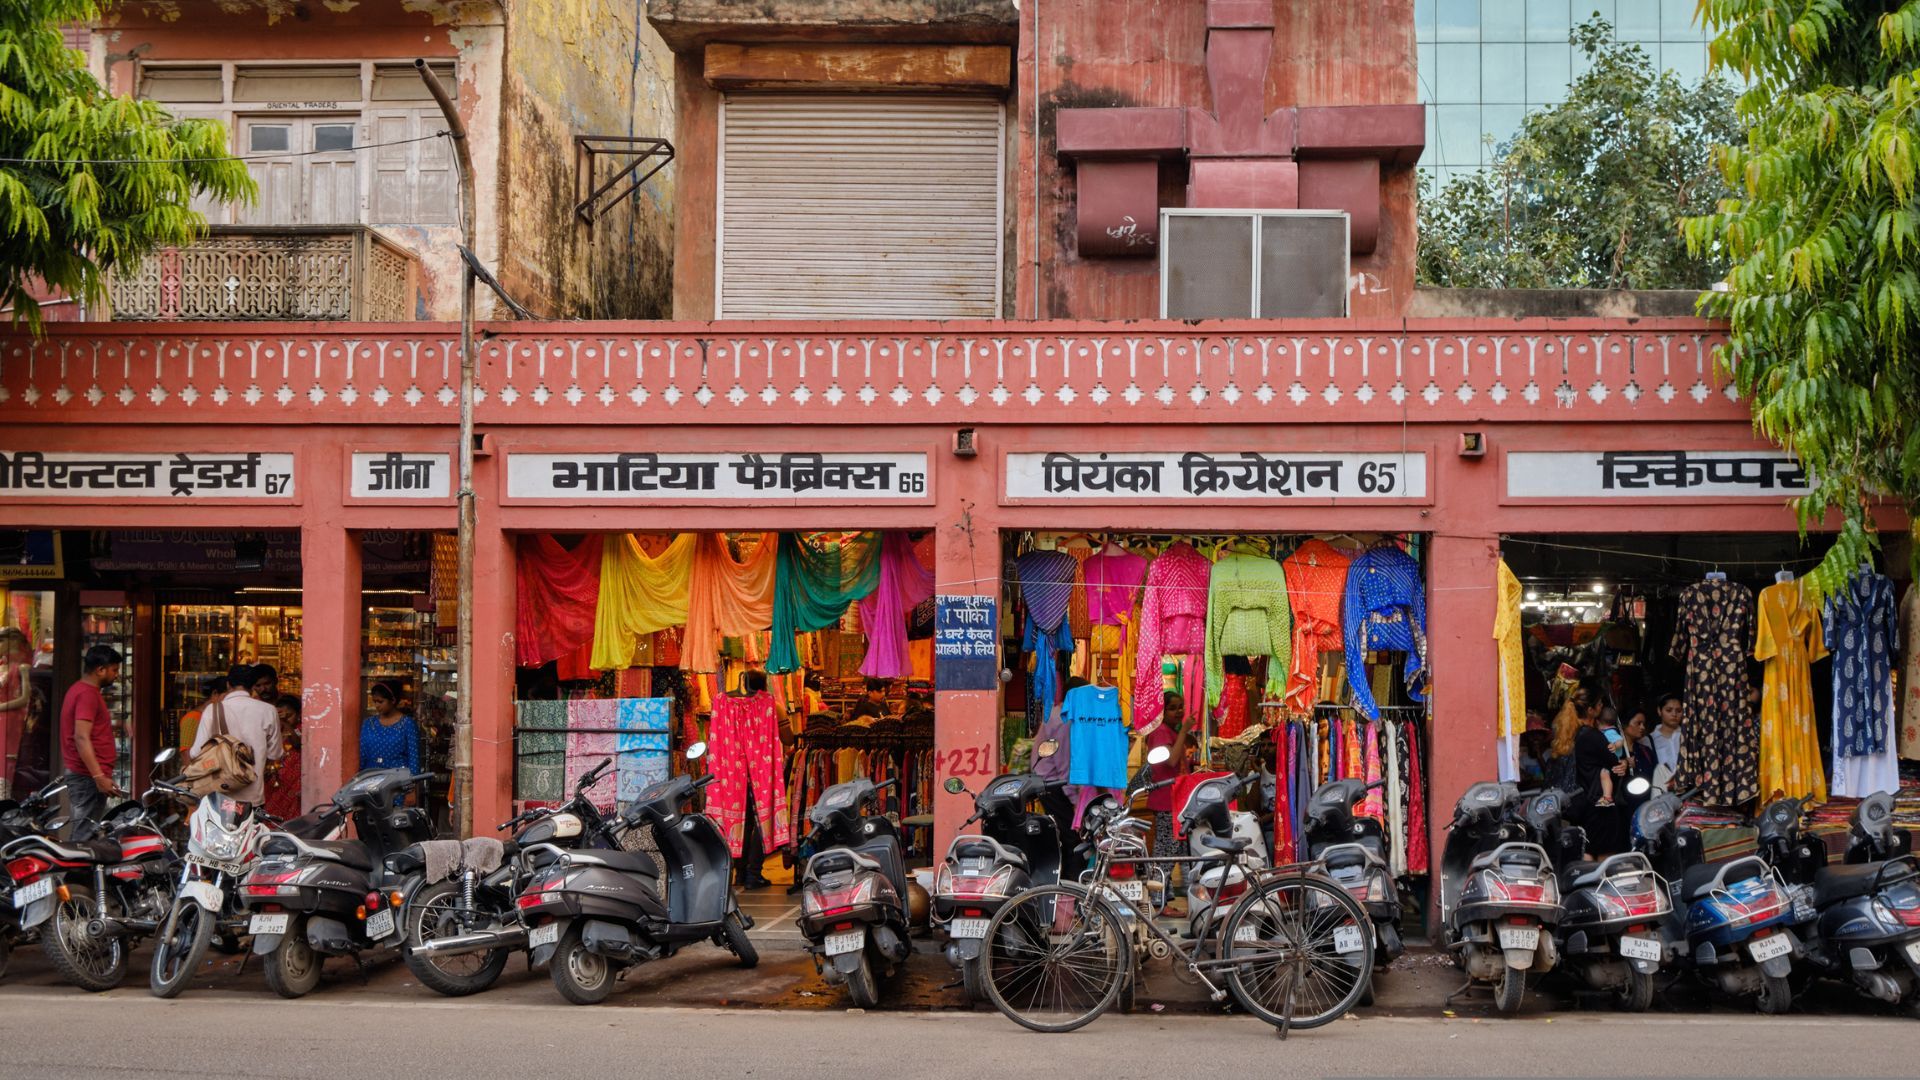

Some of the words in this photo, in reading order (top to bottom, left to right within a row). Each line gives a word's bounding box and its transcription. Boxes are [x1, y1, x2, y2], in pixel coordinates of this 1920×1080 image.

[303, 101, 338, 109] TRADERS
[169, 453, 261, 496] ट्रेडर्स
[265, 473, 291, 494] 67
[368, 452, 436, 490] जीना
[552, 453, 719, 491] भाटिया
[729, 453, 897, 493] फैब्रिक्स
[899, 472, 924, 493] 66
[1042, 452, 1164, 493] प्रियंका
[1178, 452, 1343, 496] क्रियेशन
[1357, 461, 1397, 493] 65
